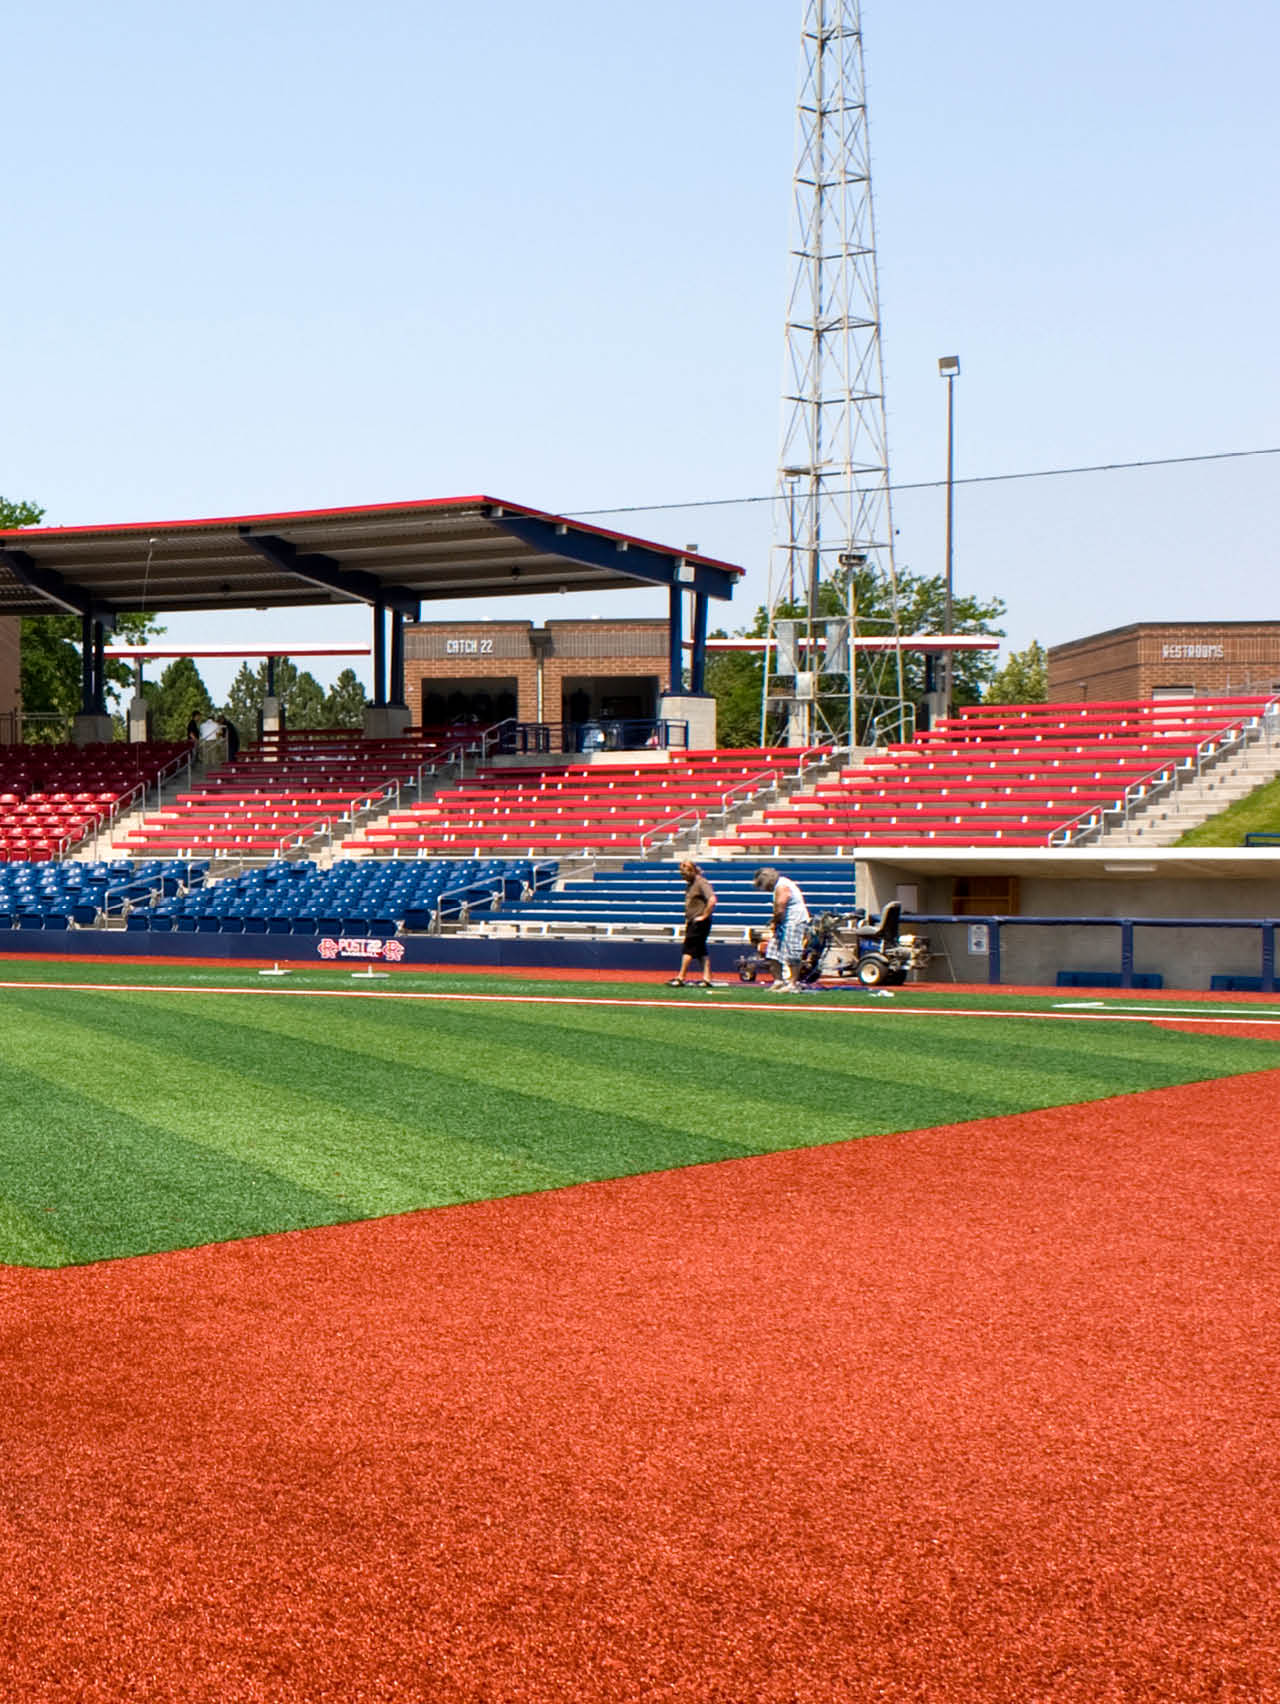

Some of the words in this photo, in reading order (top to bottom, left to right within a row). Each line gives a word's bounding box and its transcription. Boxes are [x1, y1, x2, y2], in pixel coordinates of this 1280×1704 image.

[447, 640, 477, 653] CATCH
[480, 639, 493, 653] 22
[1162, 644, 1224, 658] RESTROOMS
[338, 939, 367, 952] POST
